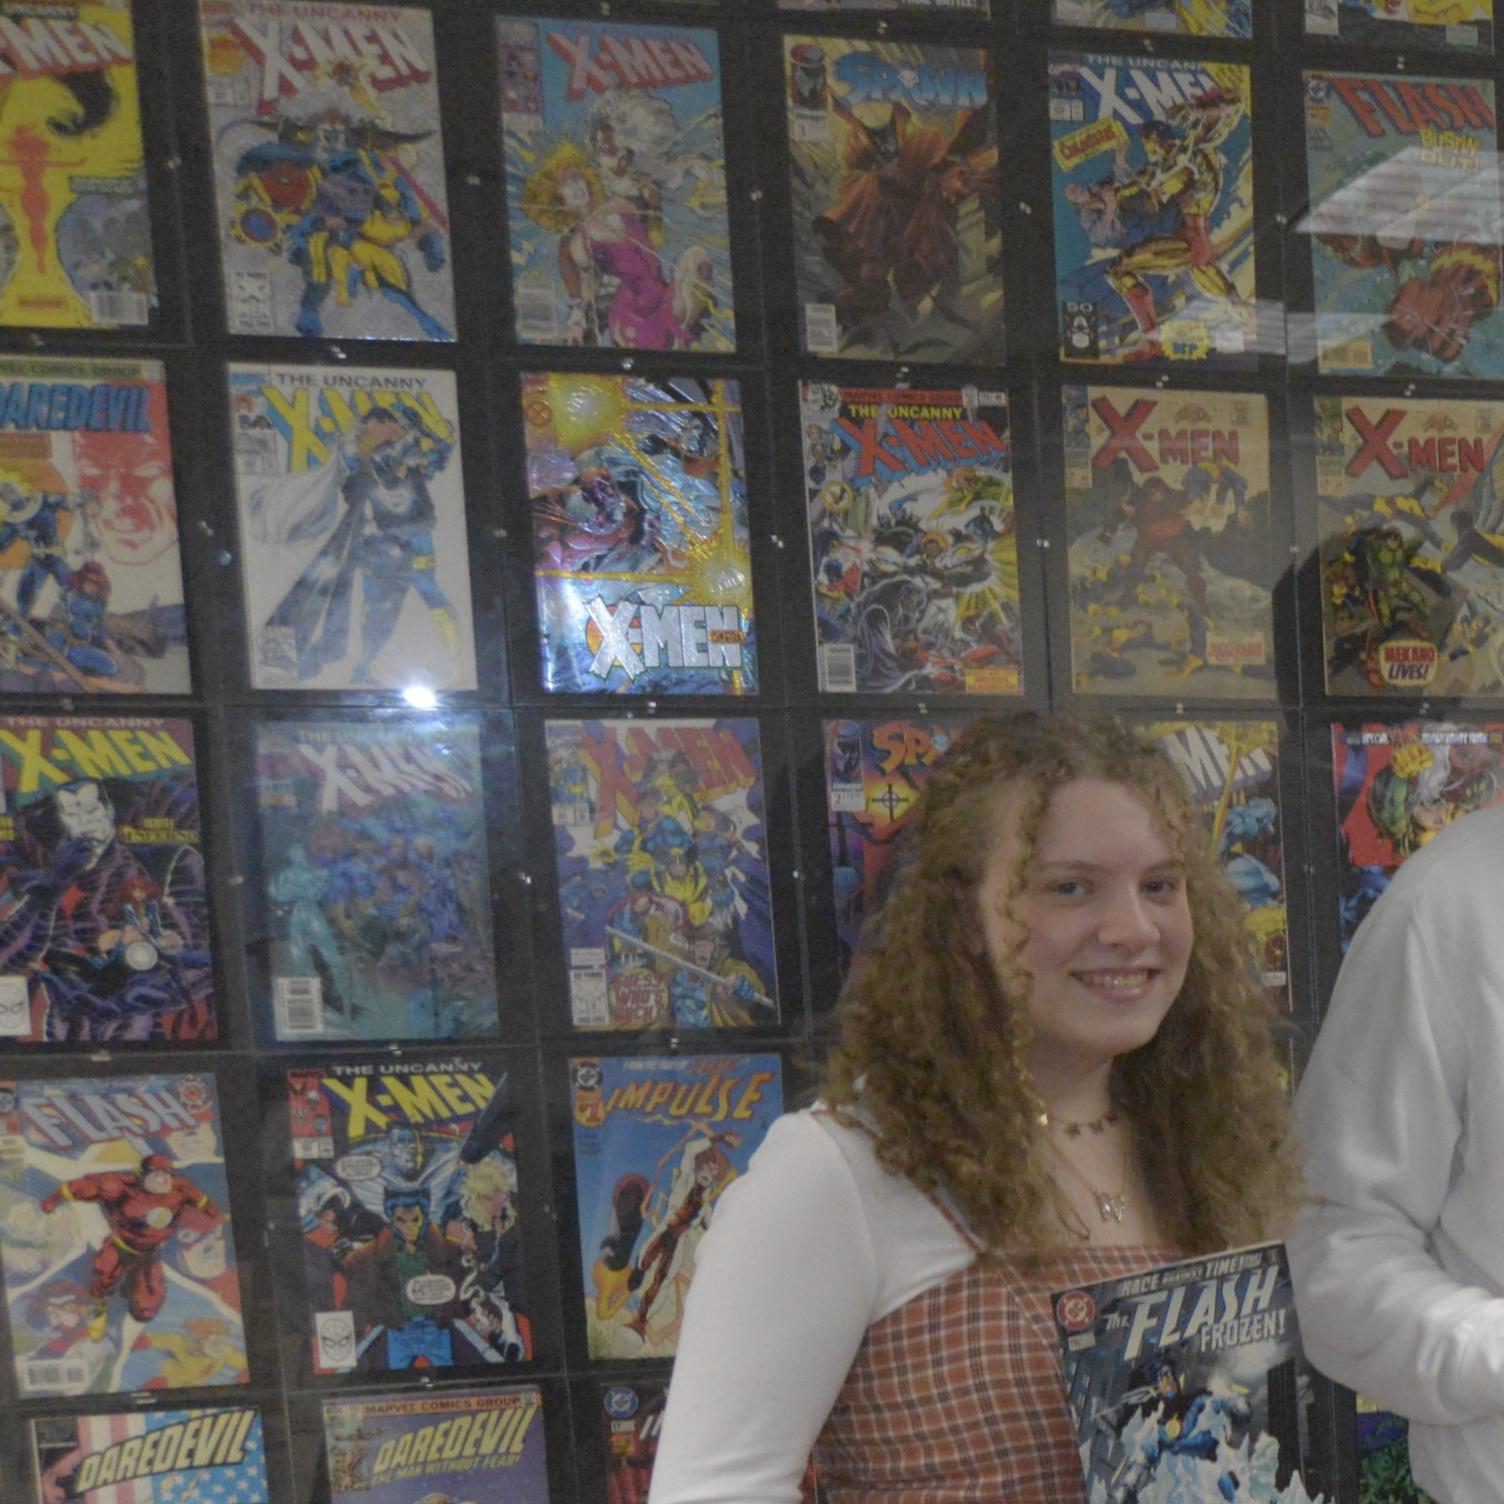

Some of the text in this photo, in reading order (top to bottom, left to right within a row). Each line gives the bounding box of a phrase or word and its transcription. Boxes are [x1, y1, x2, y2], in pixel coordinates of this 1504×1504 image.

[225, 18, 433, 116] X-MEN
[547, 31, 716, 100] X-MEN
[1085, 54, 1201, 72] THE UNCAN
[1079, 65, 1222, 125] X-ME
[1330, 76, 1495, 137] FLASH
[276, 373, 428, 392] THE UNCANNY
[848, 405, 964, 421] THE UNCANNY
[259, 384, 455, 477] X-MEN
[834, 416, 1008, 482] X-MEN
[1091, 396, 1240, 474] X-MEN
[1345, 406, 1487, 480] X-MEN
[585, 597, 741, 682] X-MEN
[1387, 662, 1430, 682] LIVES!
[10, 717, 165, 731] THE UNCANNY
[873, 720, 955, 776] SPA
[0, 729, 191, 801] X-MEN
[581, 726, 755, 839] X-MEN
[332, 1060, 483, 1077] THE UNCANNY
[605, 1070, 774, 1122] IMPULSE
[17, 1093, 198, 1155] FLASH
[324, 1072, 498, 1141] X-MEN
[1103, 1264, 1280, 1362] The FLASH
[1120, 1274, 1161, 1296] RACE
[1201, 1308, 1287, 1352] FROZEN!
[365, 1395, 521, 1415] MARVEL COMICS GROUP
[75, 1409, 255, 1497] DAREDEVIL
[372, 1406, 538, 1475] DAREDEVIL
[425, 1453, 522, 1475] WITHOUT FEAR!
